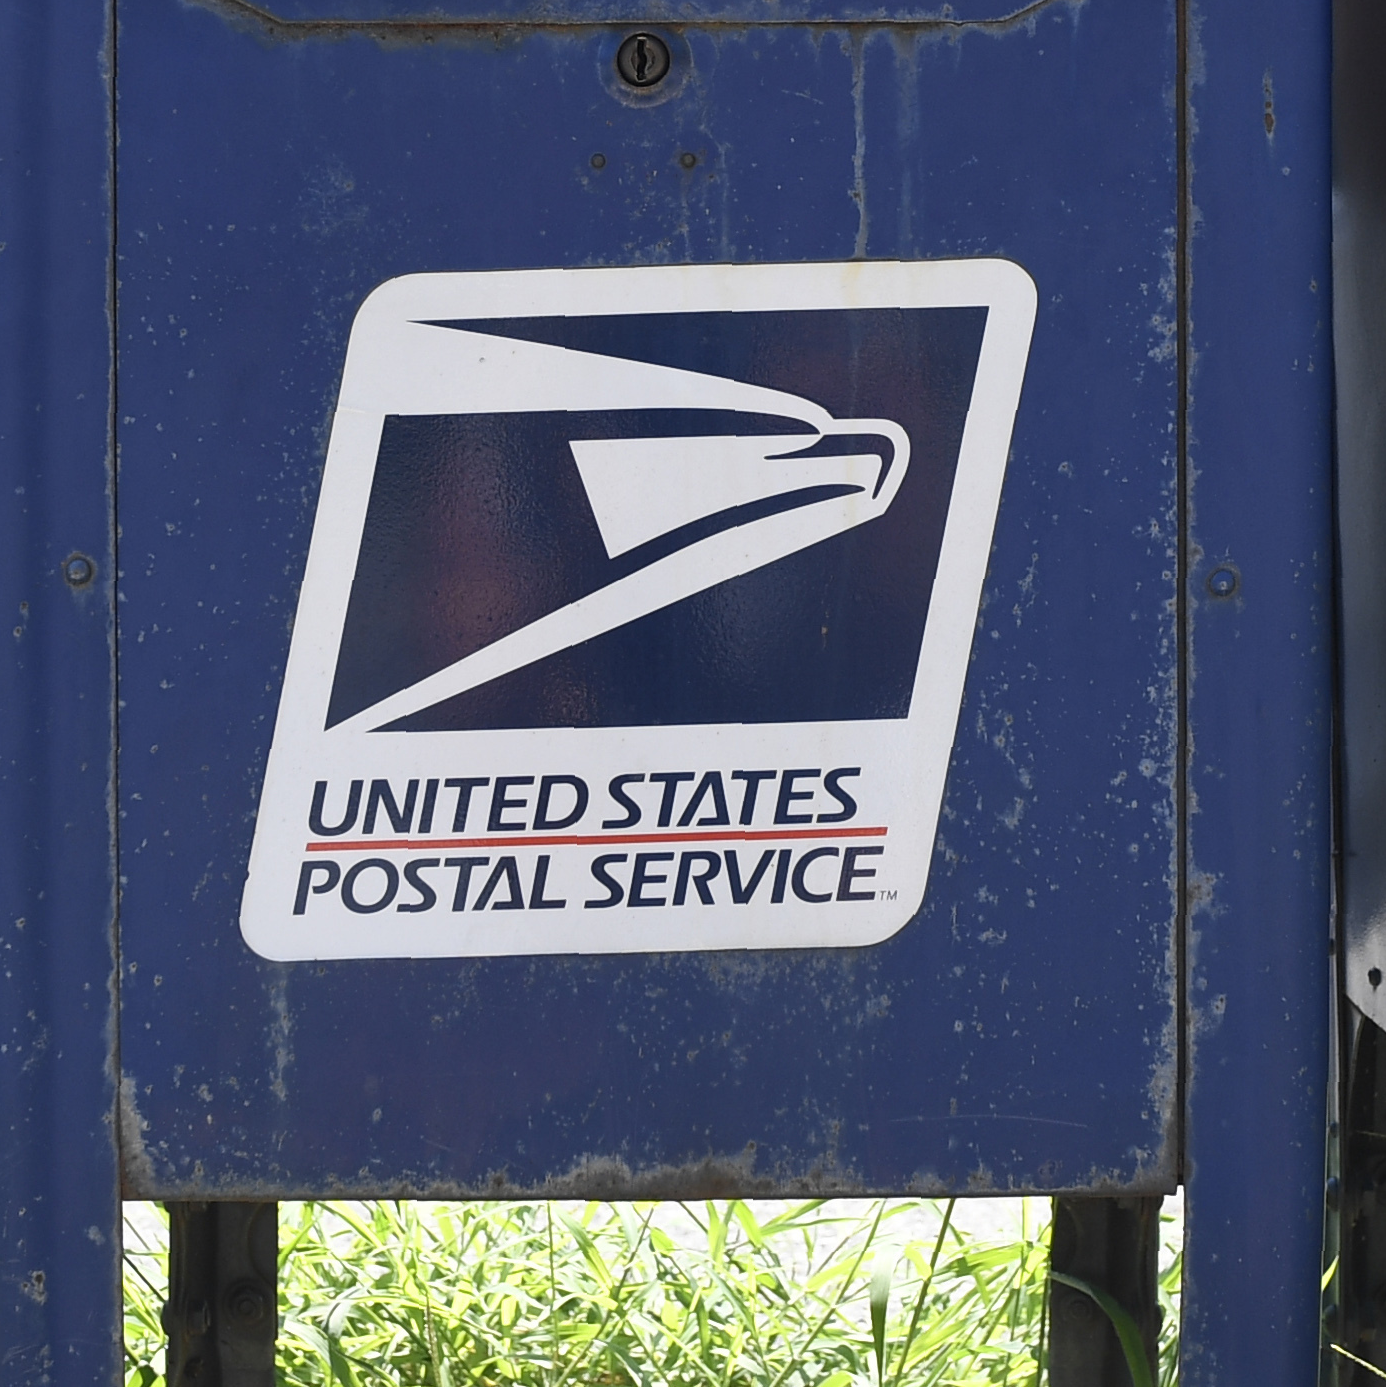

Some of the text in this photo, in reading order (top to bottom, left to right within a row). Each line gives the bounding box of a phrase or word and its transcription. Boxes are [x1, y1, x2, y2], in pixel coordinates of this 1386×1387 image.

[309, 767, 861, 836] UNITED STATES
[293, 855, 566, 915] POSTAL
[584, 846, 884, 908] SERVICE
